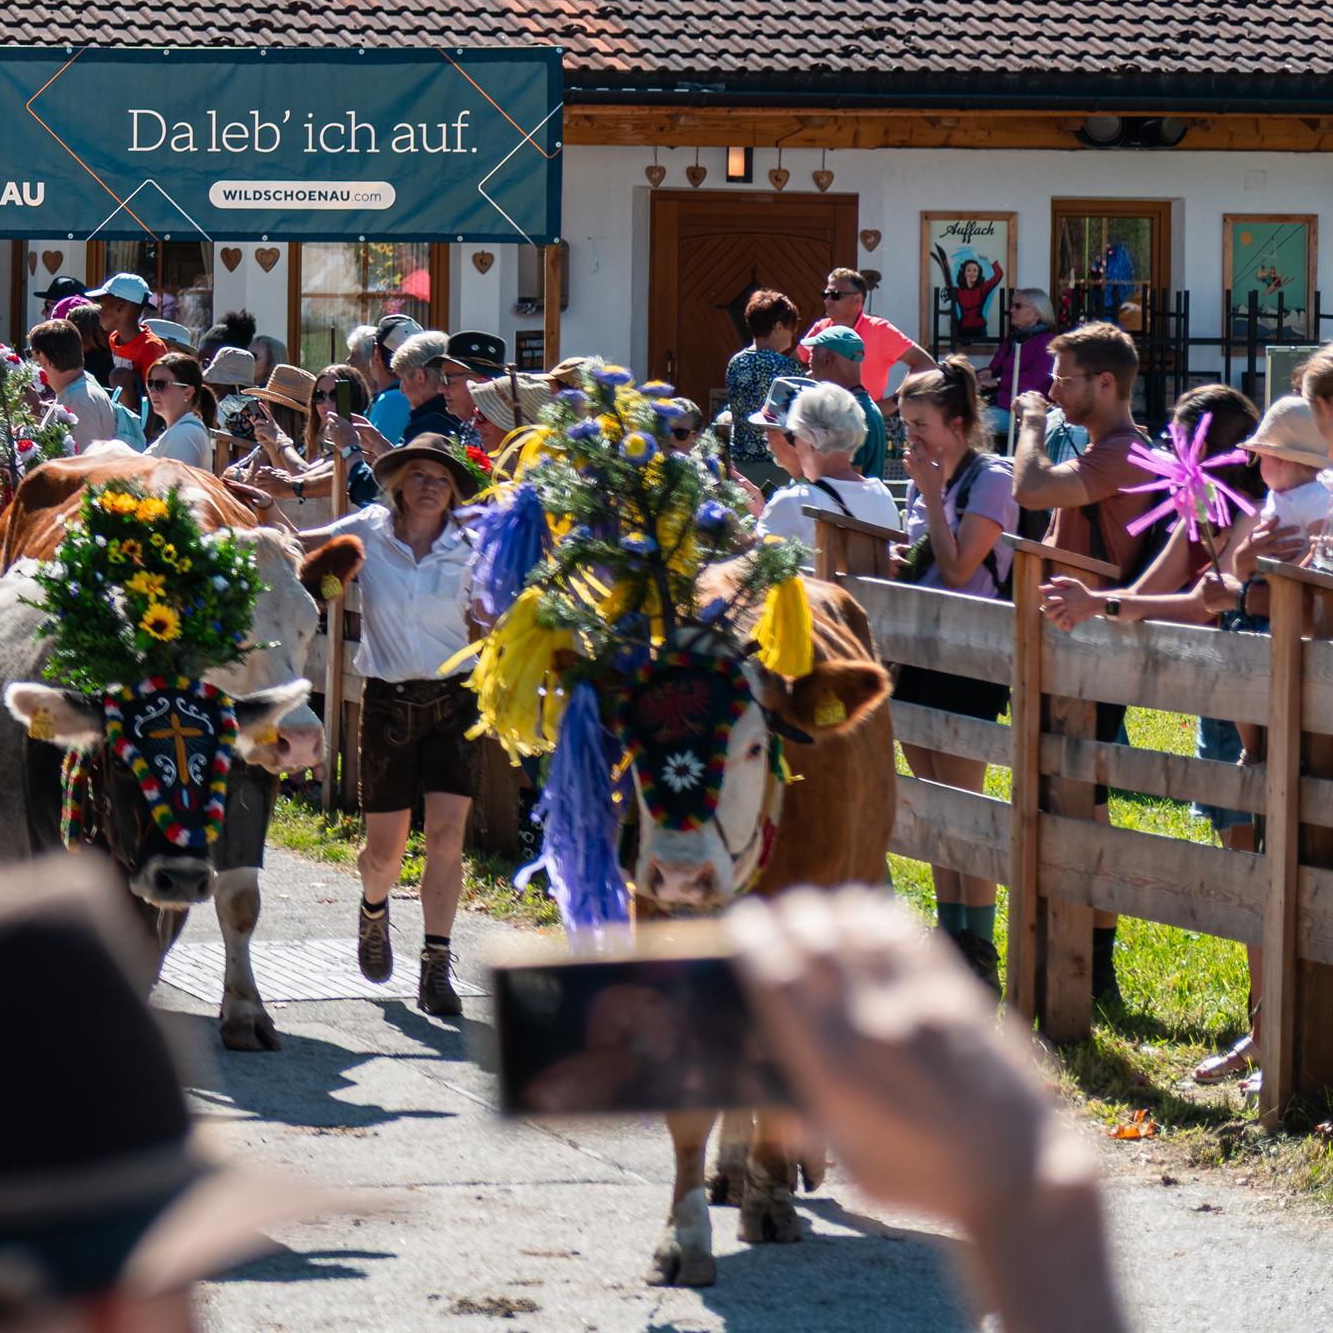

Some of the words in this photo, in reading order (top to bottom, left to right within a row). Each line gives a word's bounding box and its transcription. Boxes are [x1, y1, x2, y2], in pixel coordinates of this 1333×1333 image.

[128, 109, 199, 153] Da
[303, 110, 380, 153] ich
[391, 110, 478, 153] auf.
[223, 189, 382, 203] WILDSCHOENAU.com
[939, 221, 995, 243] Auffach
